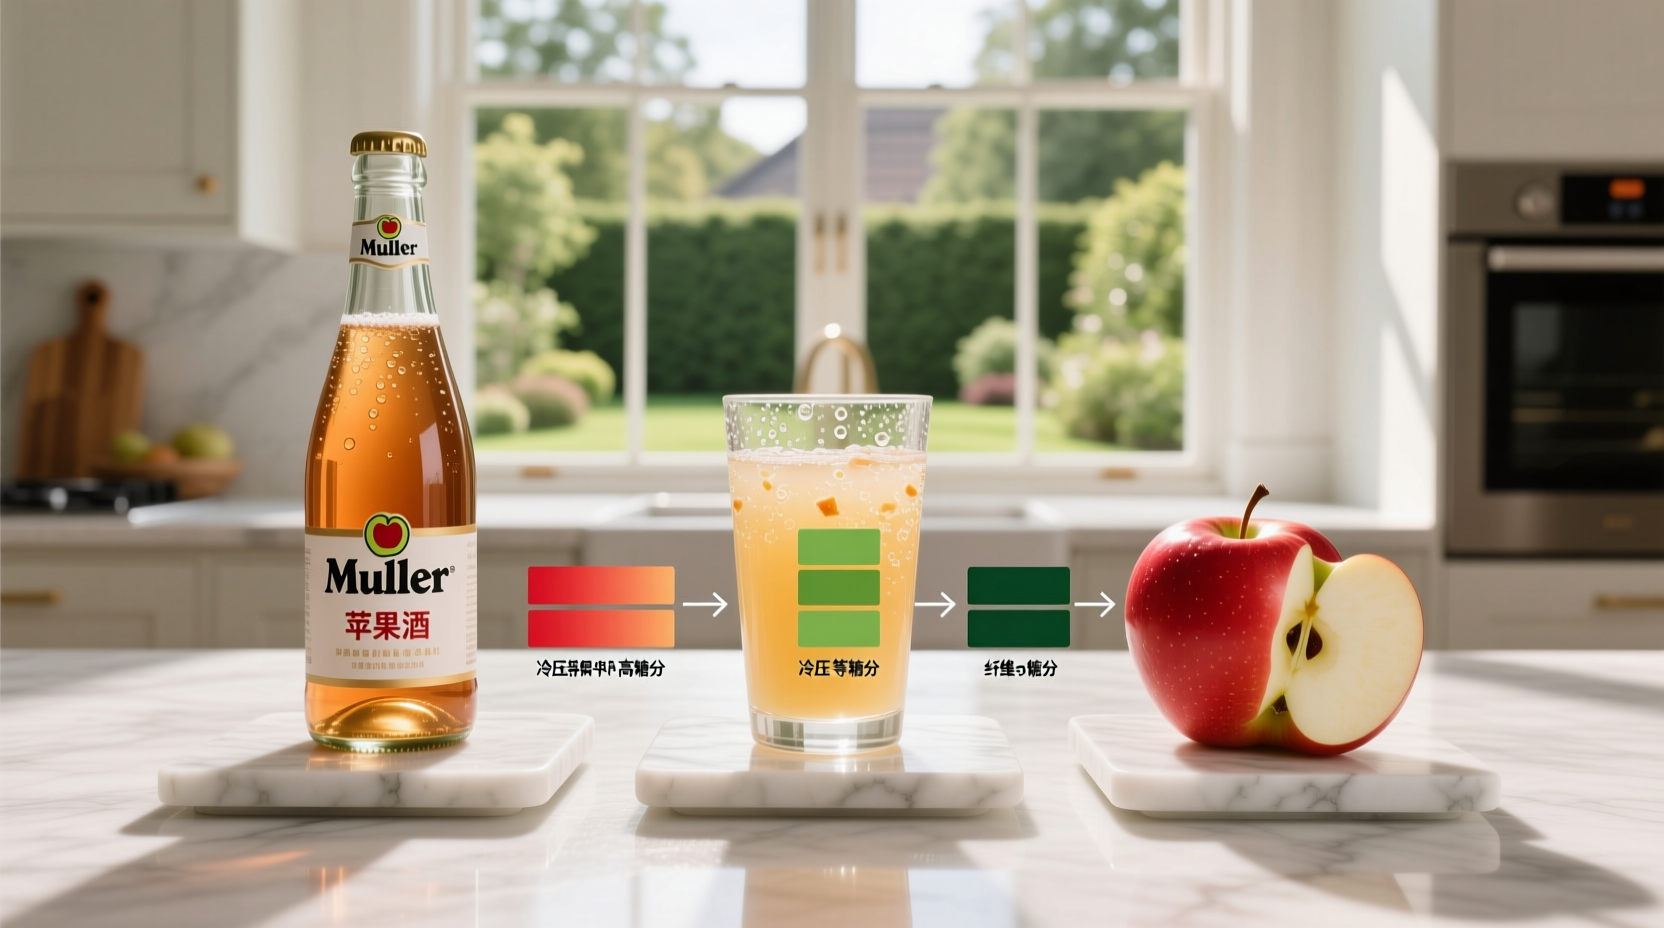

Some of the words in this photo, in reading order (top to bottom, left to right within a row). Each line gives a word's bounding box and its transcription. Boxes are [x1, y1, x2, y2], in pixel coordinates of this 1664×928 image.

[360, 238, 418, 256] Muller
[325, 558, 449, 595] Muller
[345, 610, 430, 641] 苹果酒
